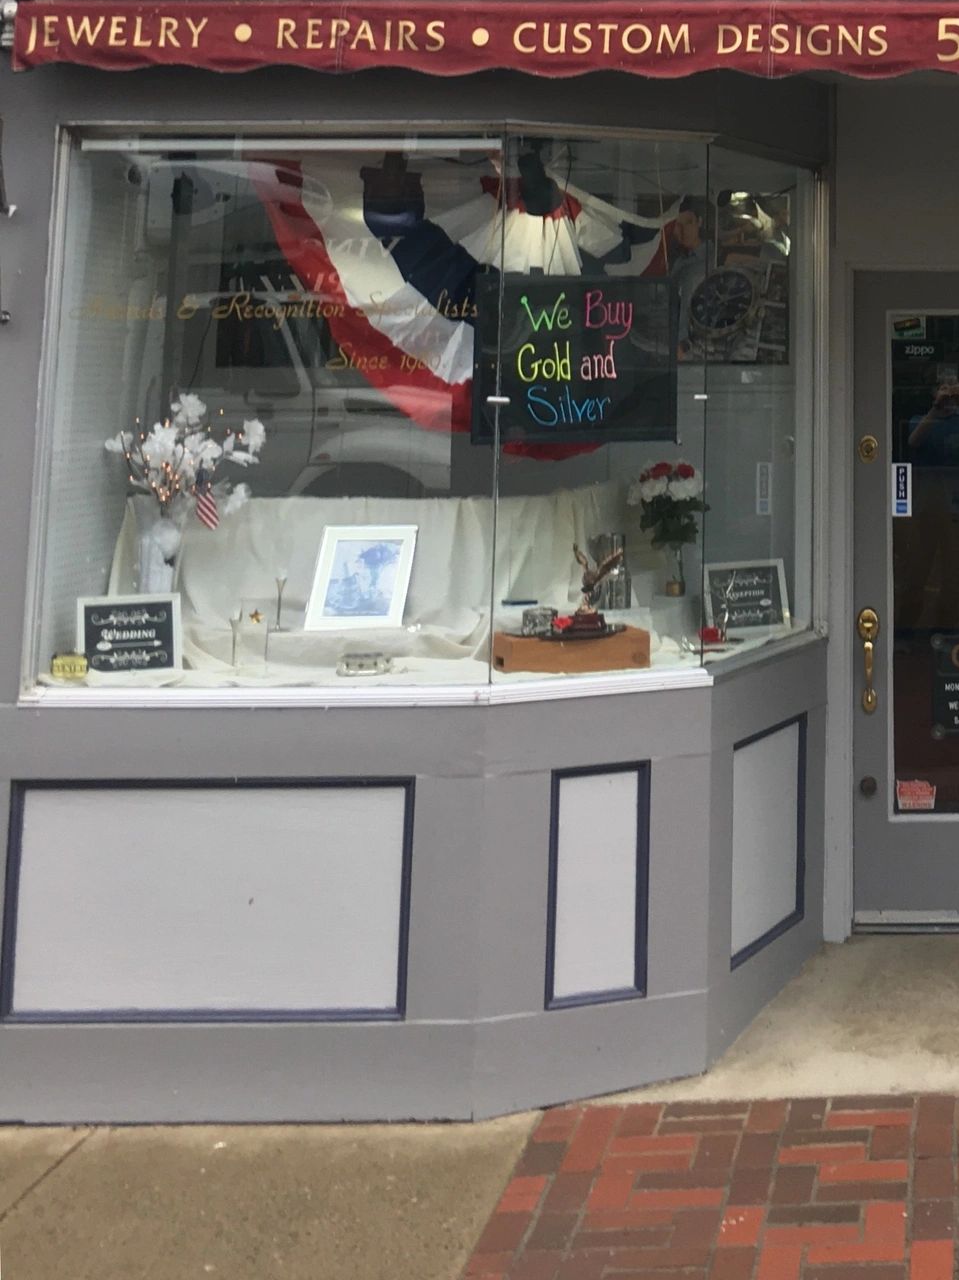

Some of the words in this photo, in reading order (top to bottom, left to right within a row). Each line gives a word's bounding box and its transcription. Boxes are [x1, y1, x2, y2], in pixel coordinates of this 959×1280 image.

[25, 15, 209, 55] JEWELRY
[276, 17, 447, 52] REPAIRS
[512, 21, 692, 56] CUSTOM
[716, 22, 889, 57] DESIGNS
[211, 292, 346, 330] Recognition
[520, 291, 573, 333] We
[584, 289, 634, 341] Buy
[325, 342, 388, 371] Since
[516, 340, 572, 383] Gold
[580, 339, 618, 381] and
[904, 344, 936, 357] zippo
[526, 384, 612, 427] Silver
[897, 466, 906, 499] PUSH
[100, 627, 157, 641] WEDDING
[944, 682, 959, 692] MON
